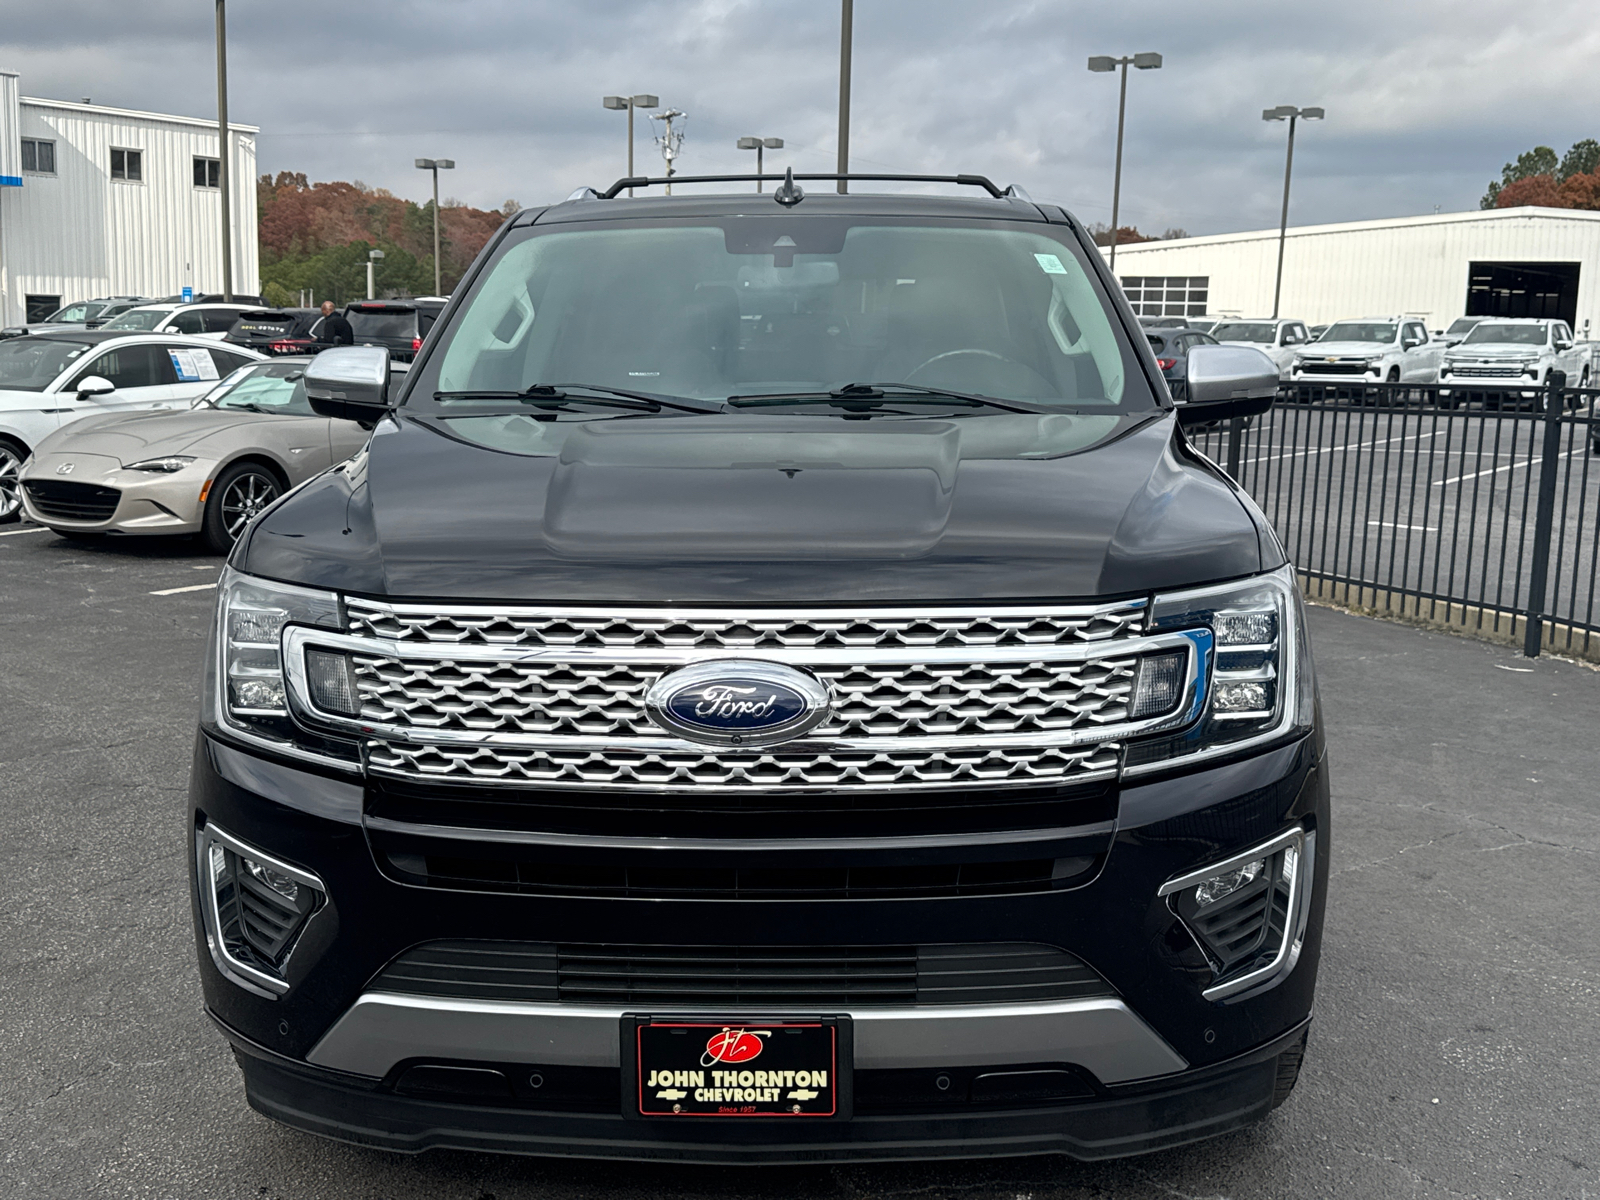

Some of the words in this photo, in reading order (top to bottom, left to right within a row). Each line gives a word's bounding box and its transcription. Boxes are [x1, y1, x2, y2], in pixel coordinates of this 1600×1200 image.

[695, 685, 777, 719] Ford
[647, 1070, 705, 1087] JOHN
[712, 1070, 828, 1087] THORNTON
[694, 1088, 781, 1102] CHEVROLET
[718, 1106, 738, 1114] Since
[739, 1106, 757, 1114] 1957
